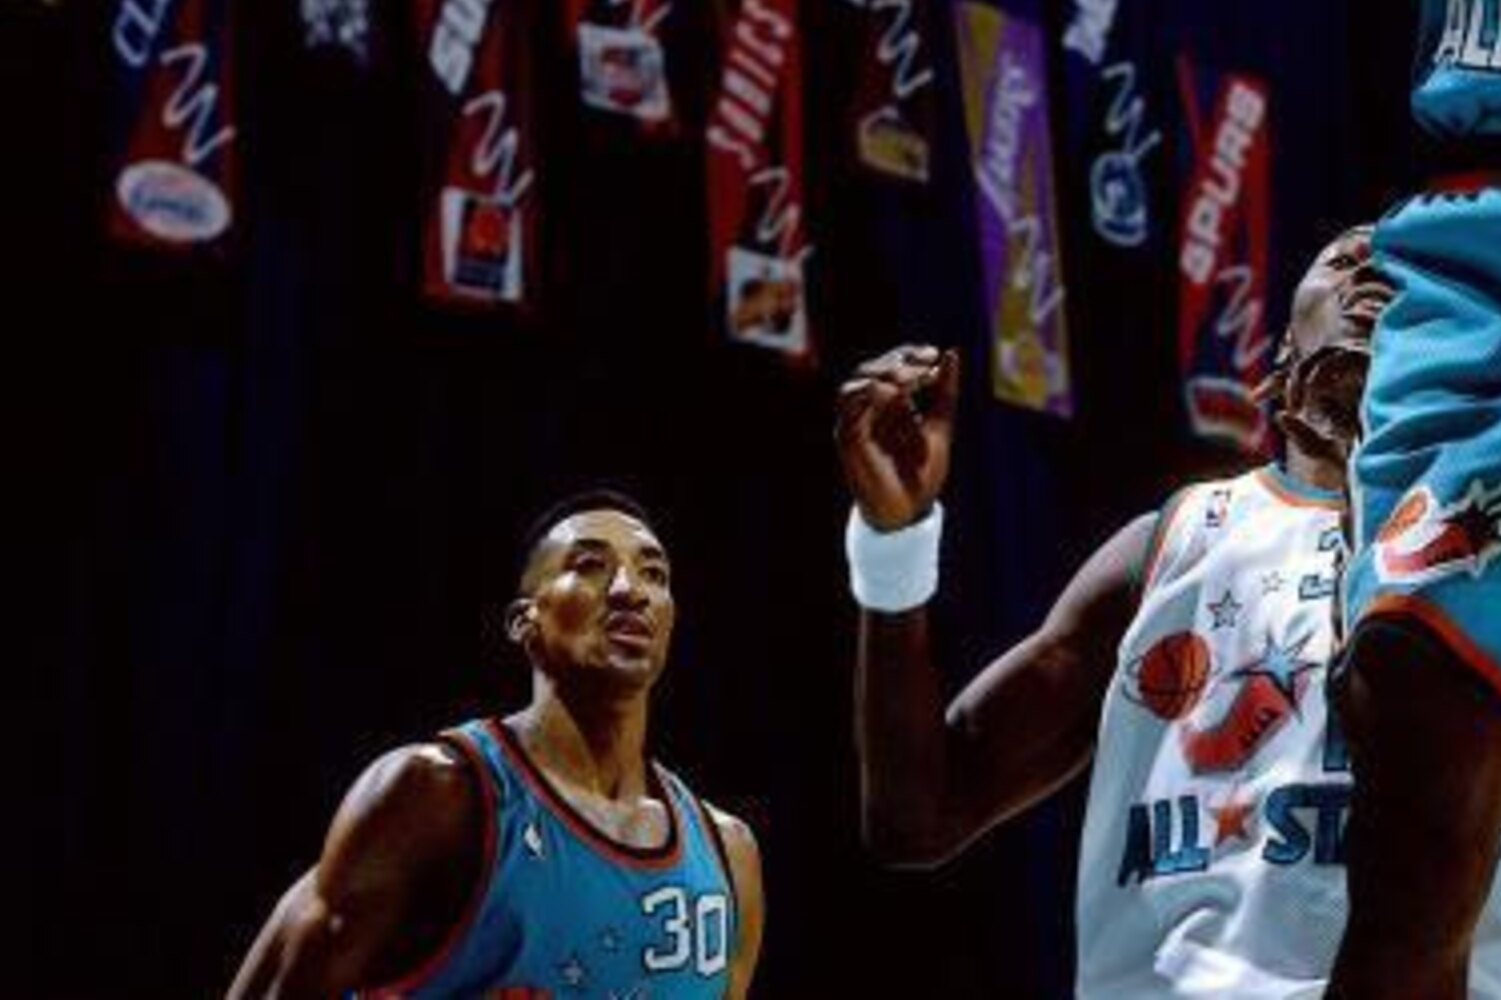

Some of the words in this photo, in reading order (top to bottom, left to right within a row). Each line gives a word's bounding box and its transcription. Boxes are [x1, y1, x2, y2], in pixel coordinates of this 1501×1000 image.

[1179, 79, 1267, 284] SPURS
[1117, 794, 1211, 888] ALL
[641, 885, 729, 976] 30
